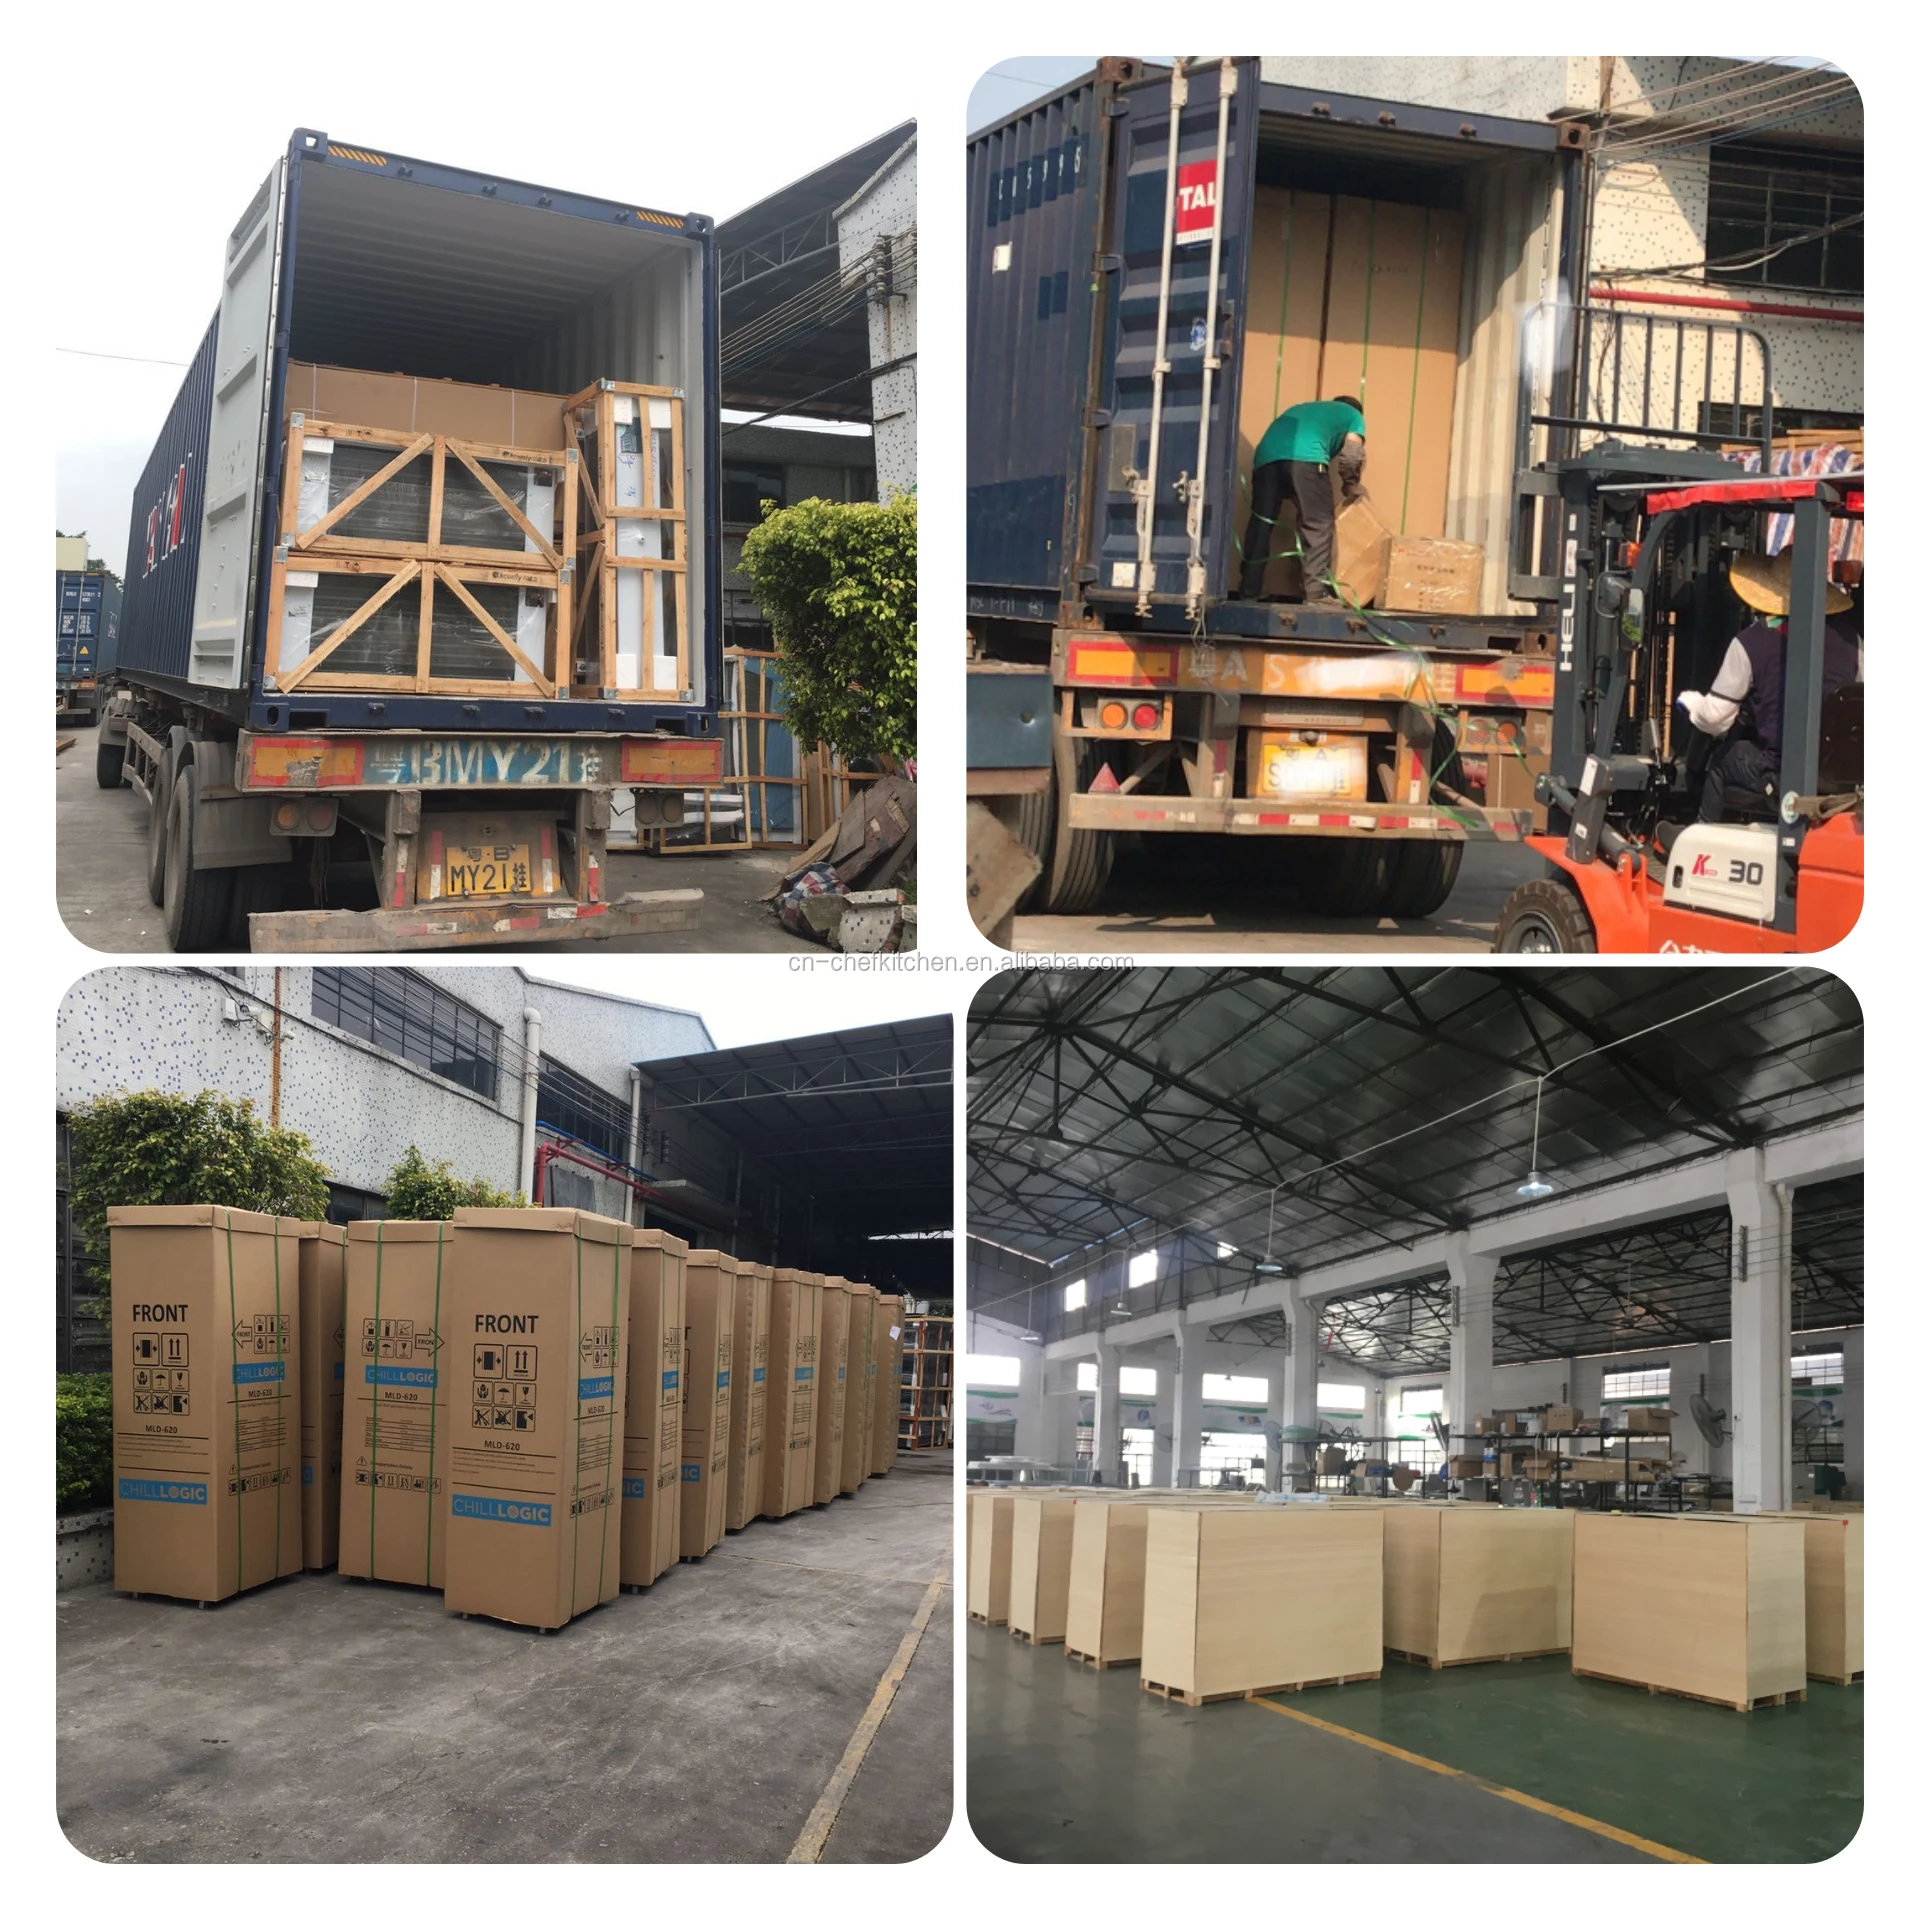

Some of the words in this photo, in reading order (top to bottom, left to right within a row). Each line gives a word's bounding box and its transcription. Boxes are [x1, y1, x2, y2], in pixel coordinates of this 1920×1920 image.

[1180, 181, 1217, 213] TAL
[1728, 859, 1764, 886] 30
[132, 1304, 189, 1322] FRONT
[475, 1314, 539, 1334] FRONT
[417, 1338, 435, 1347] FRON
[384, 1391, 418, 1401] MLD-620
[145, 1424, 178, 1434] MLD-620
[484, 1440, 521, 1451] MLD-620
[120, 1482, 206, 1501] CHILLLOGIC
[453, 1498, 550, 1523] CHILLLOGIC
